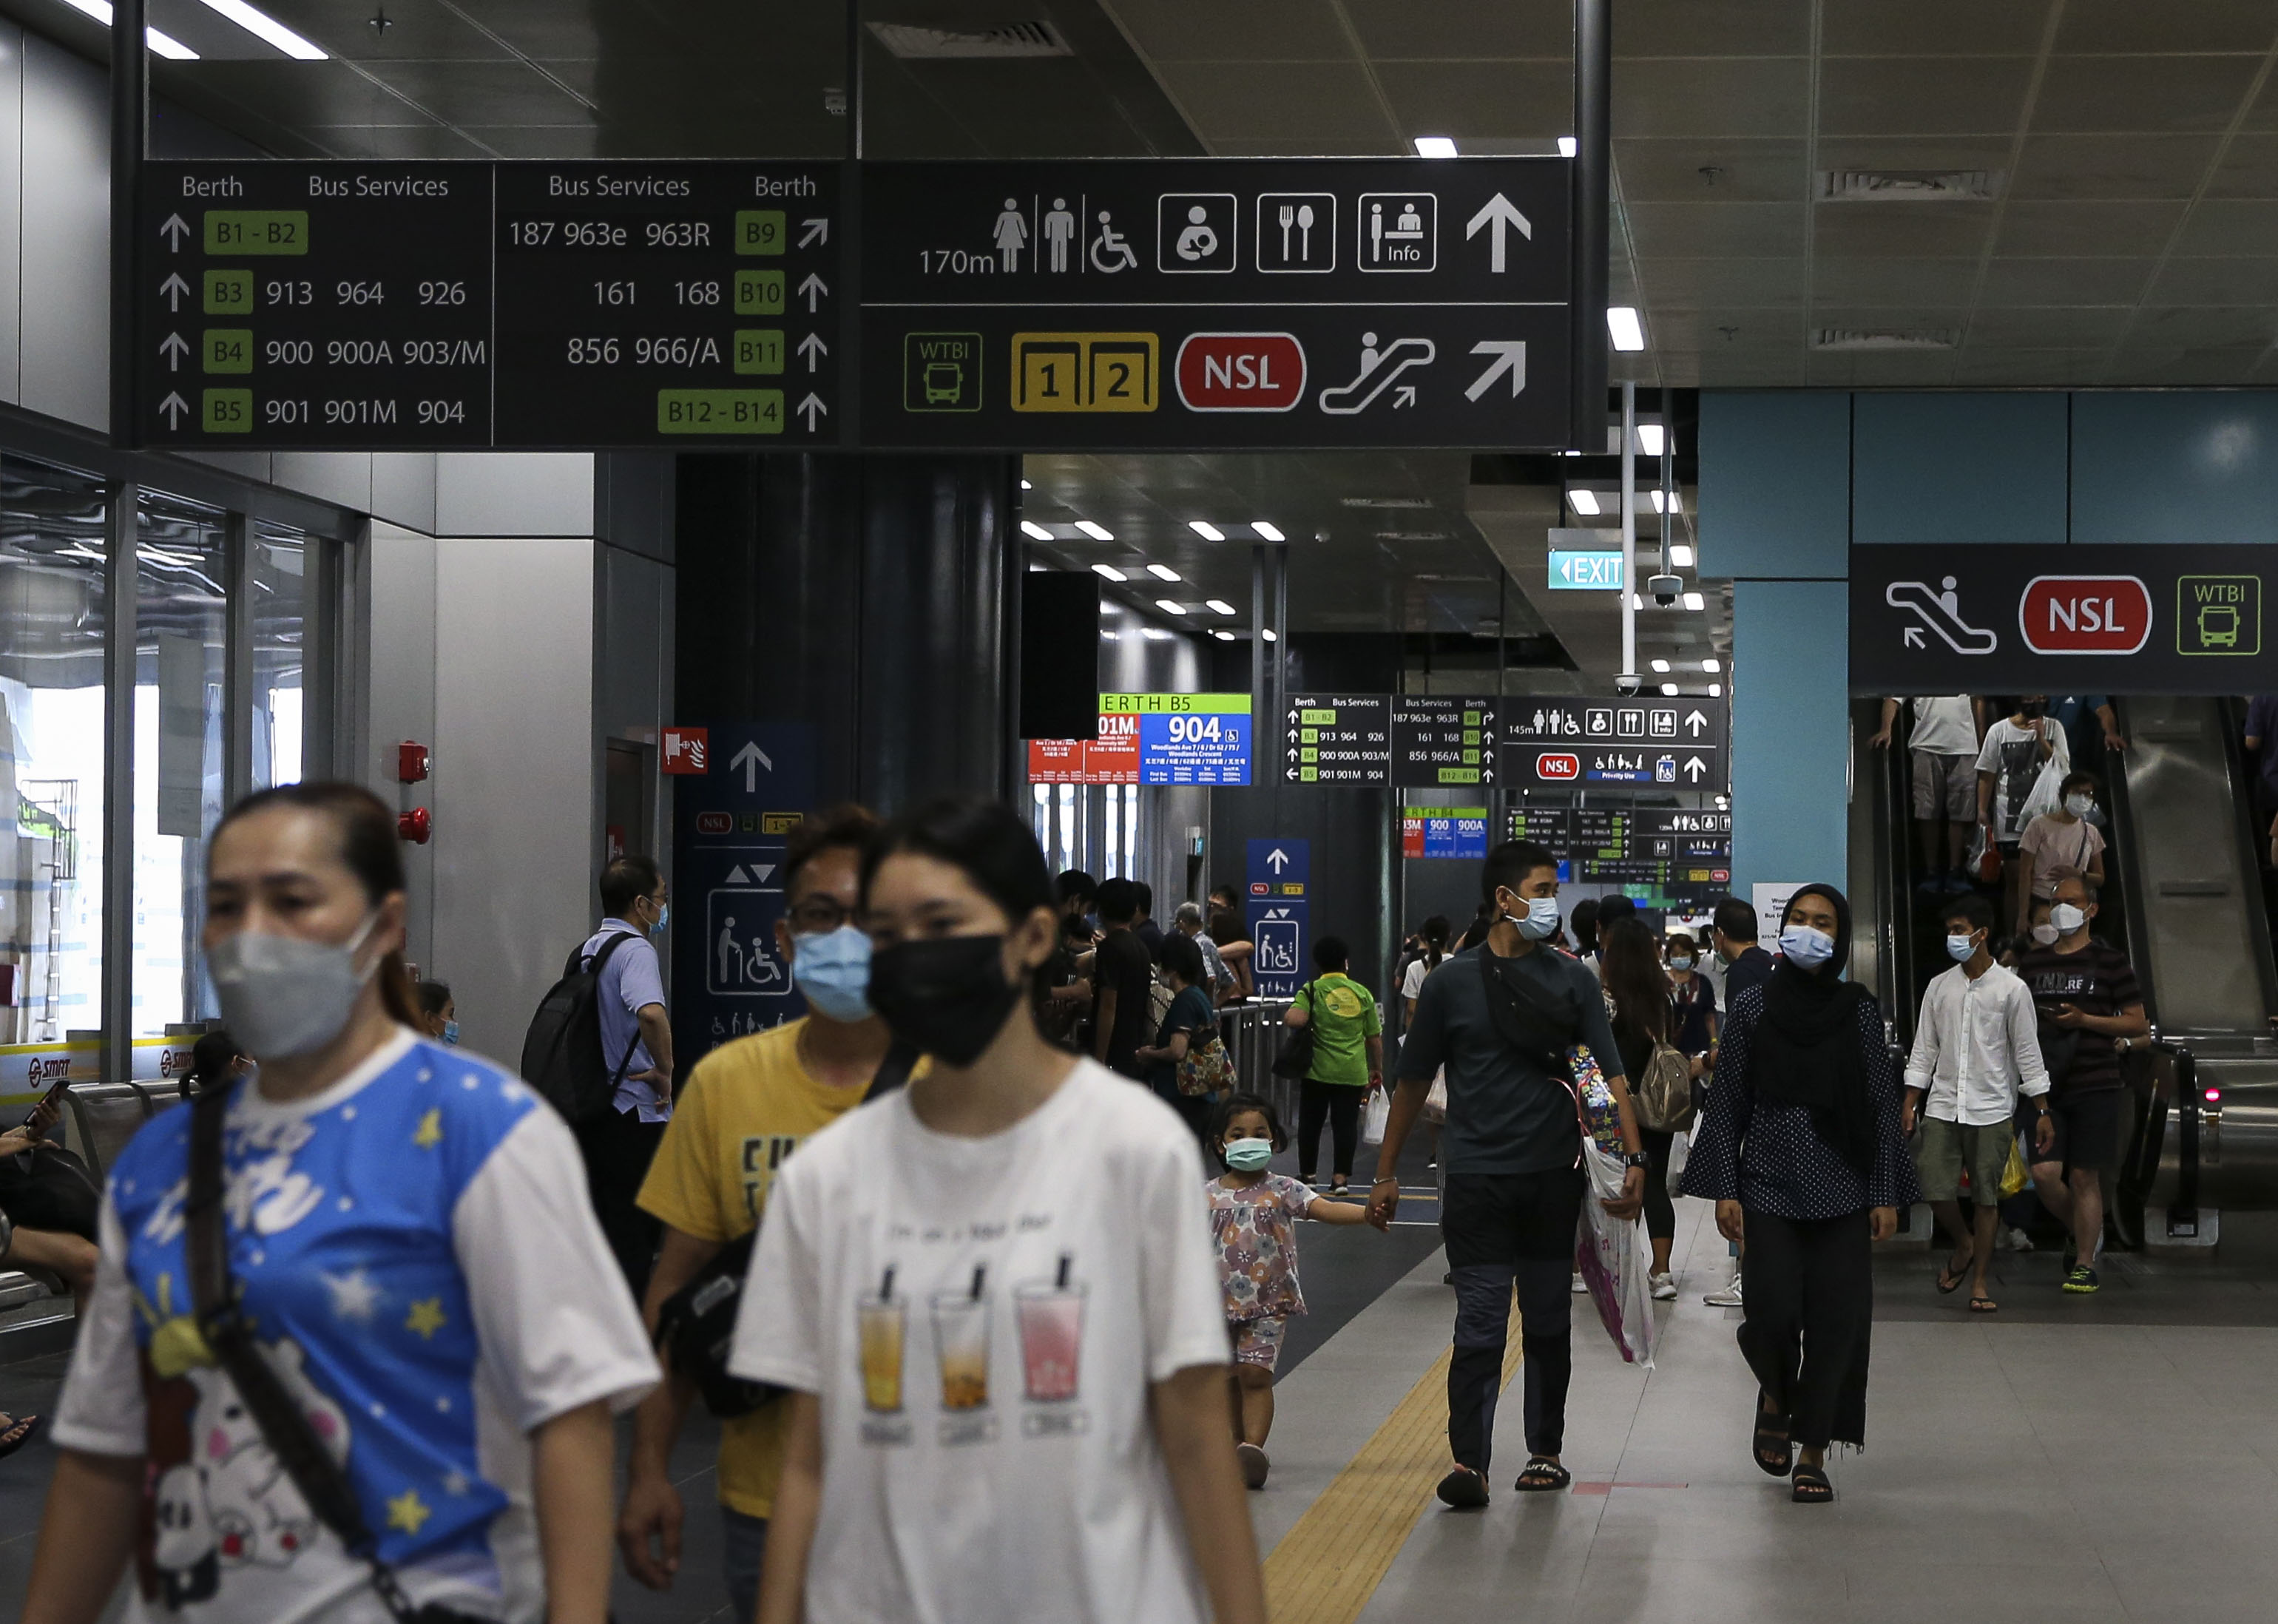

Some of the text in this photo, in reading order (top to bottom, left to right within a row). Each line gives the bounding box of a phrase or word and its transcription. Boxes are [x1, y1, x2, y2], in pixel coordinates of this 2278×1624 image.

[183, 175, 242, 196] Berth
[310, 176, 447, 195] Bus Services
[550, 175, 689, 195] Bus Services
[756, 175, 815, 196] Berth
[218, 223, 243, 243] B1
[268, 223, 296, 243] B2
[511, 223, 709, 246] 187 963e 963R
[747, 223, 774, 243] B9
[921, 251, 993, 273] 170m
[1389, 246, 1420, 260] Info
[215, 282, 242, 302] B3
[267, 282, 465, 305] 913 964 926
[595, 282, 719, 305] 161 168
[741, 283, 780, 302] B10
[214, 342, 243, 362] B4
[267, 341, 484, 365] 900 900A 903/M
[568, 338, 720, 367] 856 966/A
[741, 342, 777, 362] B11
[920, 342, 967, 359] WTBI
[1041, 363, 1129, 397] 1 2
[1206, 355, 1279, 389] NSL
[214, 401, 240, 422] B5
[266, 400, 464, 423] 901 901M 904
[669, 402, 711, 422] B12
[734, 402, 777, 422] B14
[1575, 558, 1623, 583] EXIT
[2195, 585, 2243, 602] WTBI
[2050, 598, 2124, 632] NSL
[1171, 697, 1190, 711] B5
[1333, 698, 1379, 706] Bus Services
[1393, 714, 1407, 722] 187
[1437, 714, 1458, 723] 963R
[1168, 717, 1221, 742] 904
[1320, 732, 1384, 741] 913 964 926
[1444, 734, 1459, 742] 168
[1510, 725, 1534, 734] 145m
[1320, 751, 1389, 760] 900 900A 903/M
[1410, 751, 1459, 762] 856 966/A
[1319, 771, 1383, 779] 901 901M 904
[1546, 760, 1570, 772] NSL
[704, 818, 725, 828] NSL
[1430, 820, 1448, 830] 900
[1459, 820, 1482, 830] 900A
[42, 1059, 70, 1077] SMRT
[172, 1052, 196, 1068] SMR
